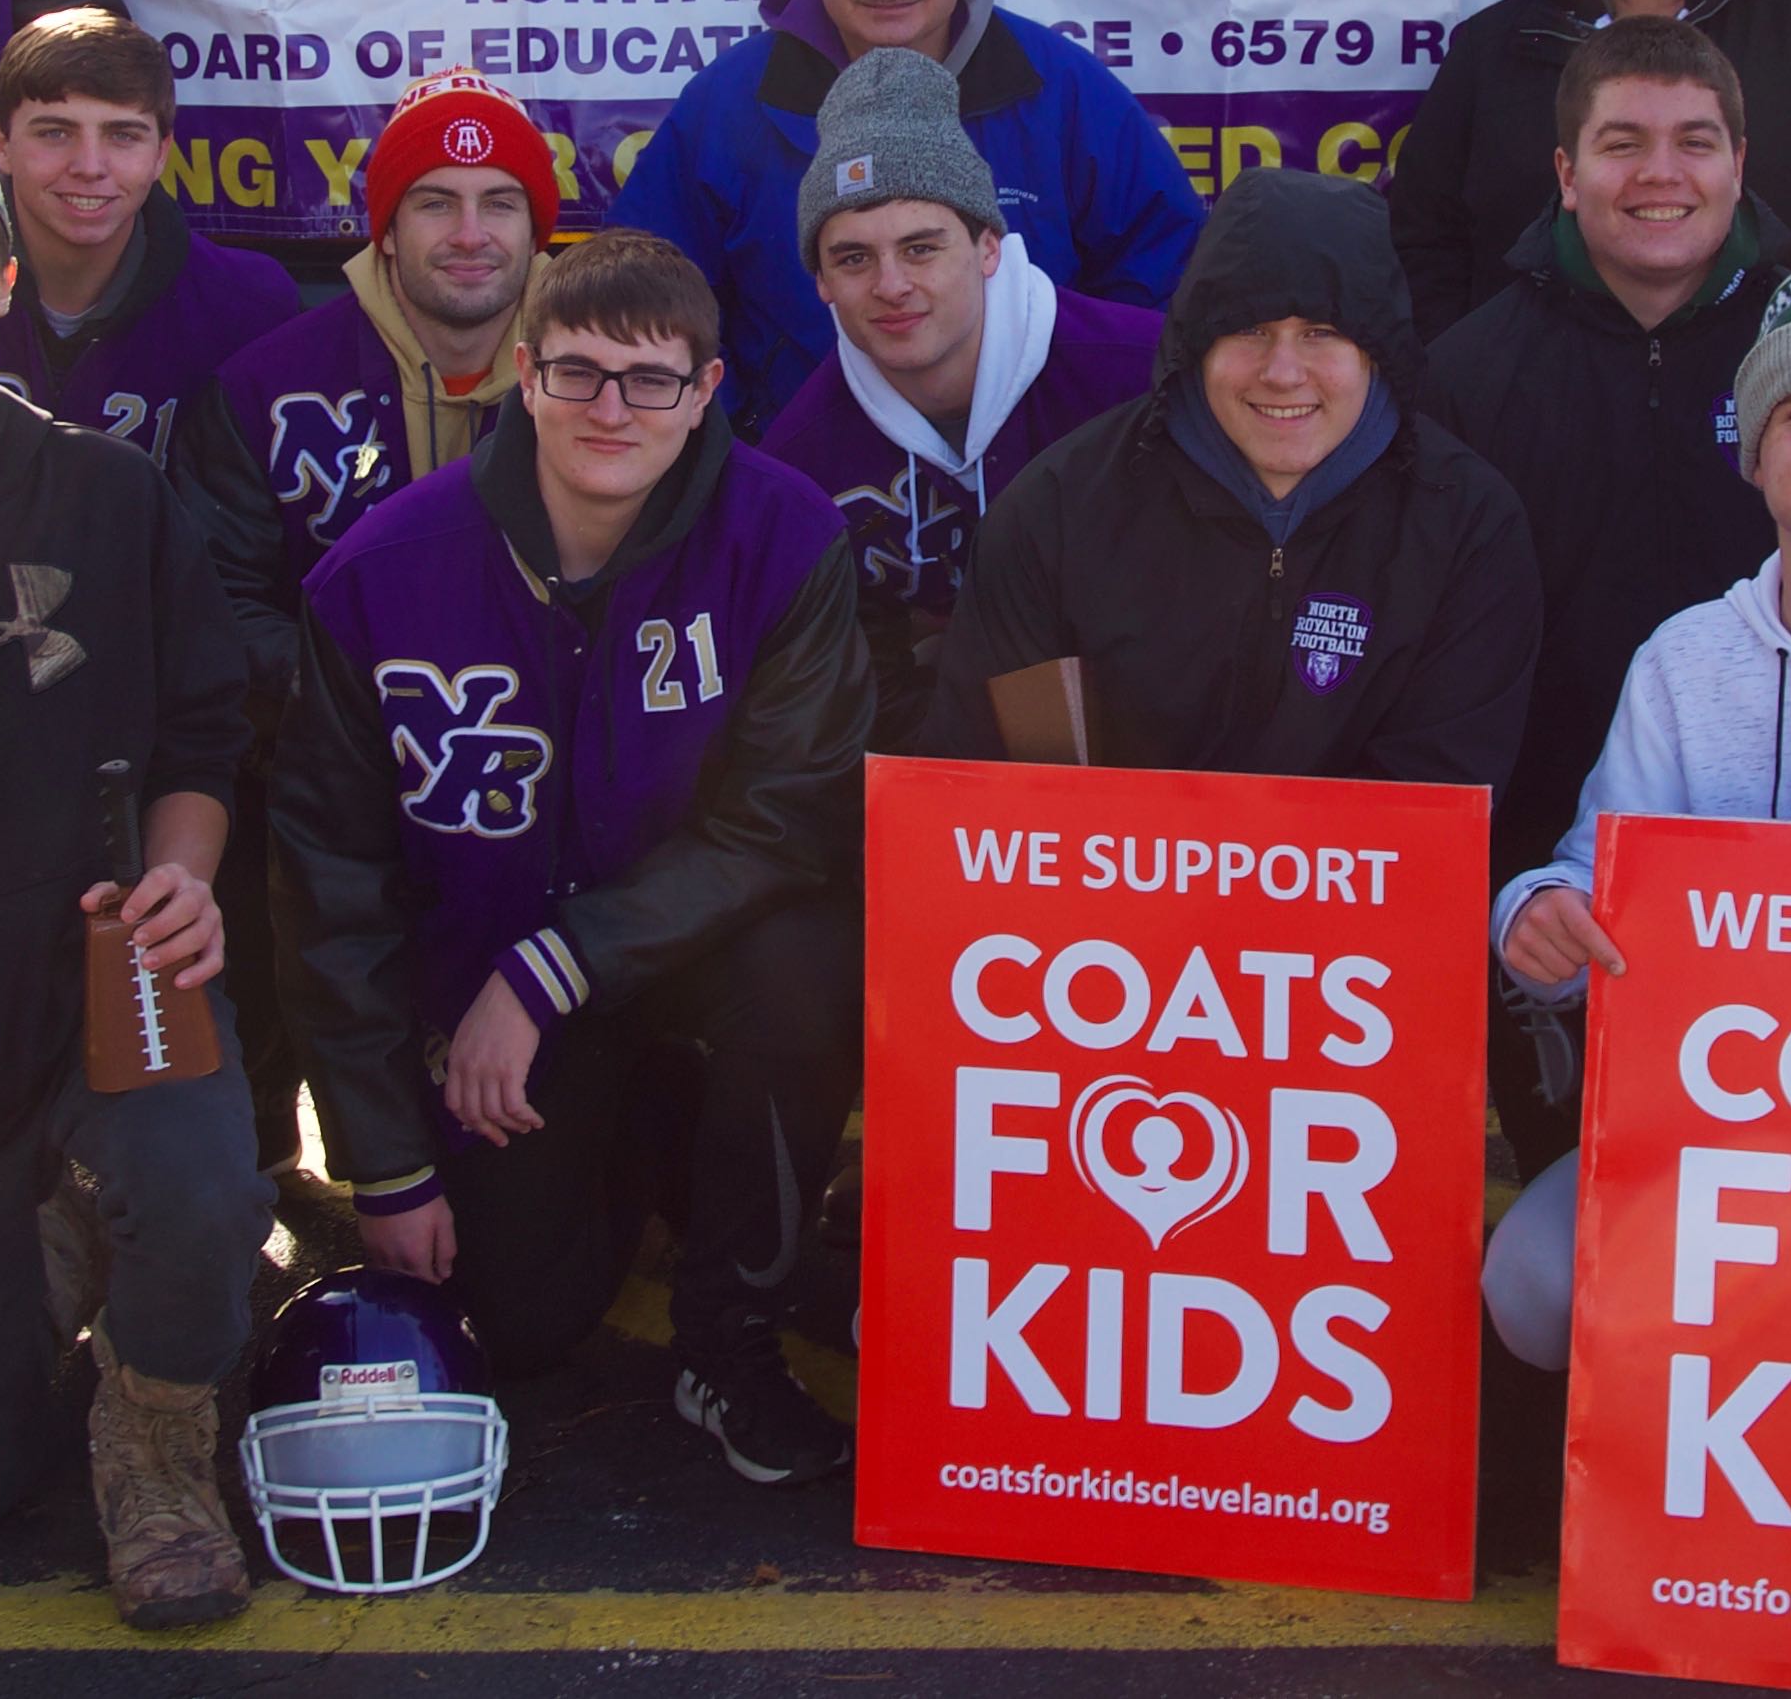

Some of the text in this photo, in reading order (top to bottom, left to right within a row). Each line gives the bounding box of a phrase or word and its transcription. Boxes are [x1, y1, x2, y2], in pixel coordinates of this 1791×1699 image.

[356, 29, 445, 80] OF
[1211, 20, 1375, 67] 6579
[1291, 633, 1364, 657] FOOTBALL
[1295, 616, 1368, 641] ROYALTON
[1308, 601, 1359, 622] NORTH
[636, 612, 724, 713] 21
[954, 827, 1400, 905] WE SUPPORT
[951, 933, 1394, 1068] COATS
[341, 1365, 396, 1384] Riddell
[950, 1257, 1394, 1444] KIDS
[940, 1458, 1391, 1534] coatsforkidscleveland.org
